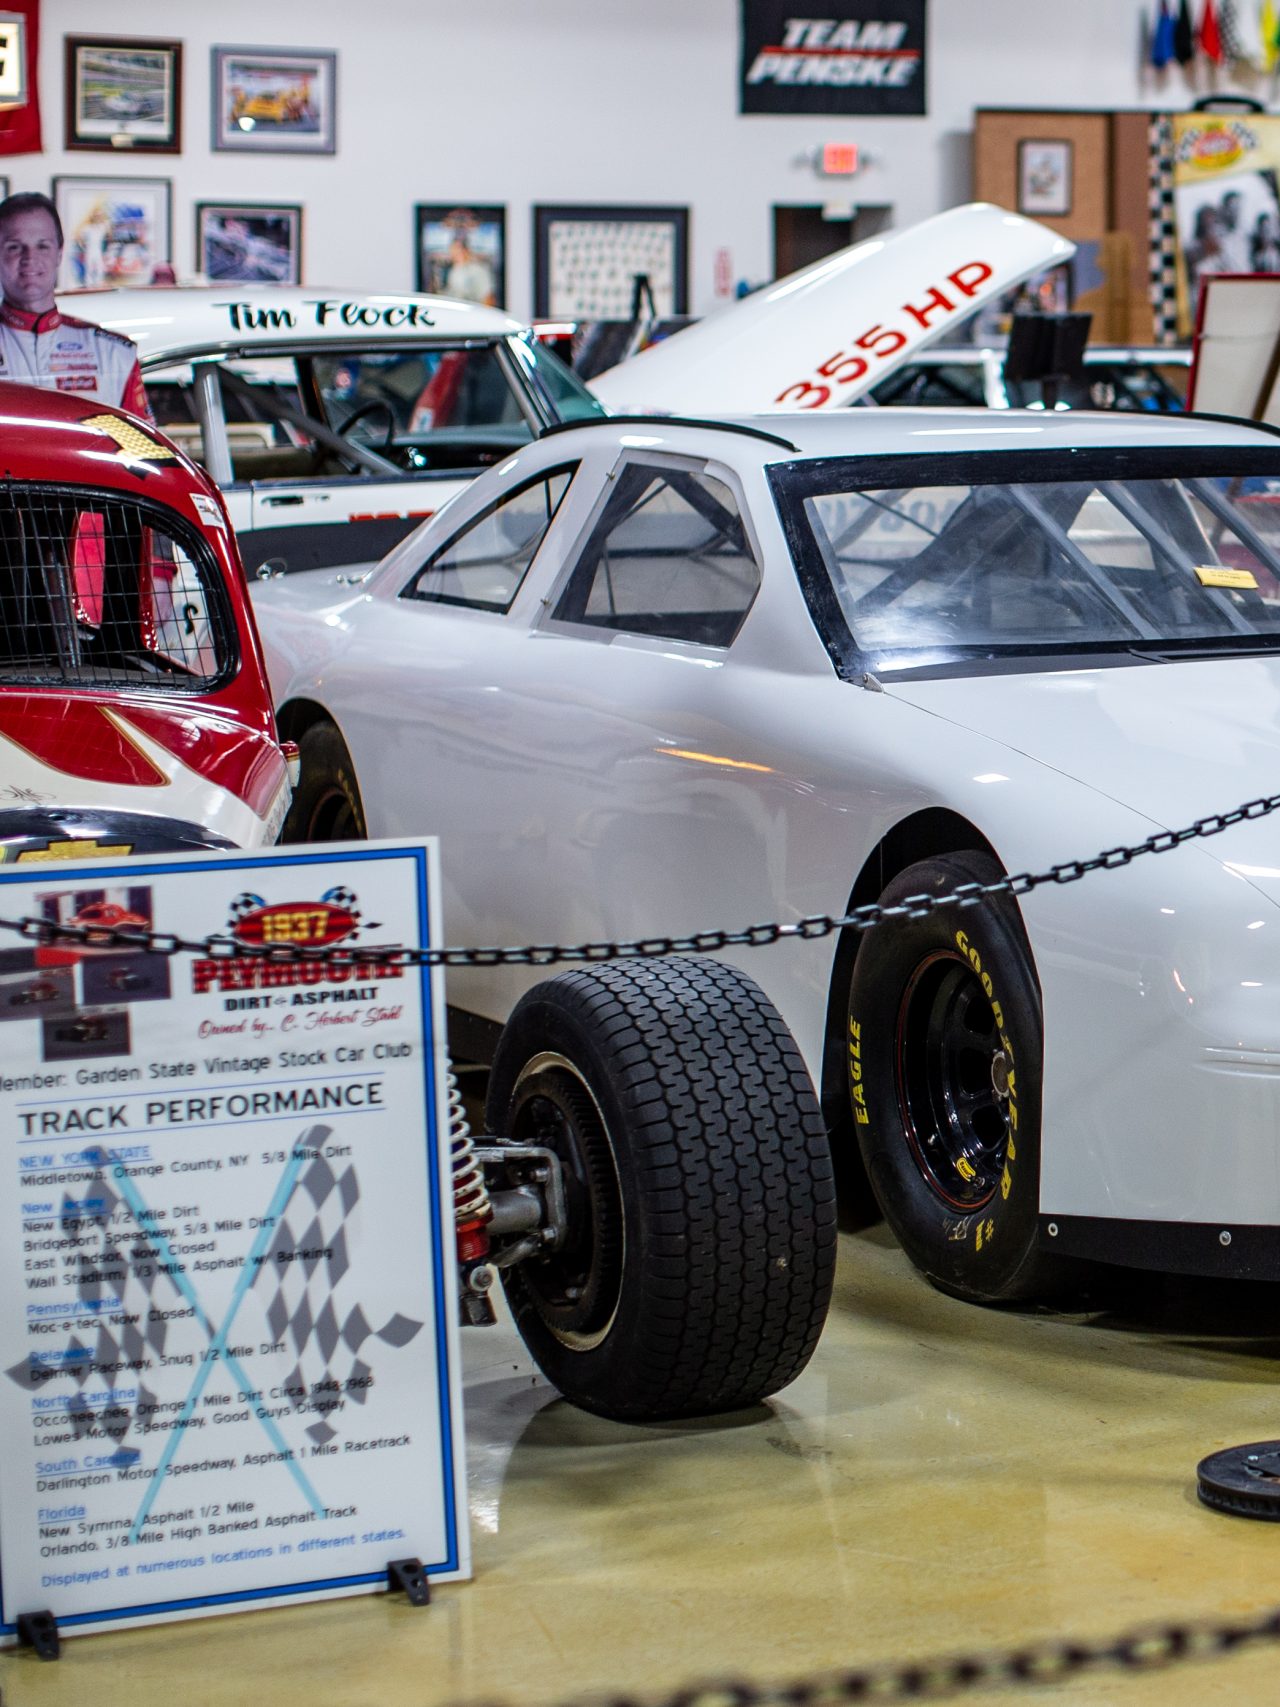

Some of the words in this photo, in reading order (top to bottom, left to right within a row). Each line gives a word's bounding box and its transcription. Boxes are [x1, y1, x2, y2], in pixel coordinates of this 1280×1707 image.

[783, 19, 908, 50] TEAM
[746, 53, 918, 87] PENSKE
[212, 301, 297, 331] Tim
[303, 298, 436, 329] Flock
[775, 324, 907, 409] 355
[903, 261, 993, 329] HP
[261, 910, 329, 942] 1937
[225, 996, 272, 1012] DIRT
[291, 987, 379, 1006] ASPHALT
[198, 1018, 247, 1039] Owned
[304, 1009, 365, 1031] Herbert
[361, 1006, 404, 1027] Stahl
[76, 1066, 142, 1085] Garden
[149, 1062, 196, 1079] State
[204, 1055, 271, 1074] Vintage
[279, 1051, 327, 1068] Stock
[335, 1046, 364, 1062] Car
[373, 1042, 412, 1059] Club
[849, 1014, 871, 1125] EAGLE
[956, 930, 1020, 1200] GOODYEAR
[18, 1104, 128, 1136] TRACK
[146, 1082, 383, 1125] PERFORMANCE
[20, 1155, 53, 1169] NEW
[109, 1146, 150, 1161] STATE
[114, 1163, 164, 1179] Orange
[171, 1157, 222, 1173] County,
[229, 1155, 248, 1166] NY
[262, 1153, 284, 1165] 5/8
[292, 1149, 320, 1161] Mile
[326, 1145, 352, 1157] Dirt
[21, 1201, 53, 1214] New
[22, 1221, 54, 1233] New
[111, 1212, 131, 1224] 1/2
[138, 1208, 167, 1221] Mile
[173, 1205, 199, 1218] Dirt
[24, 1234, 98, 1252] Bridgeport
[184, 1223, 208, 1235] 5/8
[214, 1219, 242, 1232] Mile
[249, 1215, 276, 1229] Dirt
[25, 1257, 55, 1271] East
[130, 1248, 161, 1261] Now
[168, 1241, 216, 1256] Closed
[26, 1276, 56, 1290] Wall
[158, 1261, 186, 1275] Mile
[277, 1247, 333, 1264] Banking
[109, 1313, 140, 1325] Now
[148, 1306, 196, 1321] Closed
[160, 1353, 193, 1368] Snug
[200, 1349, 220, 1361] 1/2
[226, 1344, 253, 1358] Mile
[260, 1342, 286, 1354] Dirt
[32, 1393, 70, 1409] North
[136, 1400, 186, 1416] Orange
[204, 1393, 231, 1407] Mile
[238, 1390, 264, 1403] Dirt
[269, 1386, 305, 1400] Circa
[34, 1431, 80, 1447] Lowes
[87, 1426, 127, 1441] Motor
[213, 1411, 250, 1425] Good
[256, 1405, 291, 1420] Guys
[295, 1399, 346, 1415] Display
[35, 1458, 76, 1474] South
[36, 1474, 110, 1493] Darlington
[117, 1467, 158, 1482] Motor
[243, 1449, 294, 1466] Asphalt
[311, 1443, 338, 1457] Mile
[344, 1434, 410, 1452] Racetrack
[37, 1504, 86, 1521] Florida
[39, 1526, 70, 1540] New
[141, 1509, 194, 1525] Asphalt
[200, 1505, 220, 1518] 1/2
[226, 1501, 254, 1515] Mile
[105, 1536, 129, 1550] 3/8
[136, 1531, 164, 1546] Mile
[170, 1527, 201, 1542] High
[208, 1519, 258, 1535] Banked
[265, 1512, 316, 1528] Asphalt
[322, 1505, 357, 1520] Track
[41, 1568, 109, 1588] Displayed
[116, 1564, 130, 1577] at
[136, 1556, 204, 1574] numerous
[211, 1546, 273, 1564] locations
[279, 1543, 292, 1554] in
[297, 1535, 355, 1552] different
[361, 1528, 405, 1544] states.
